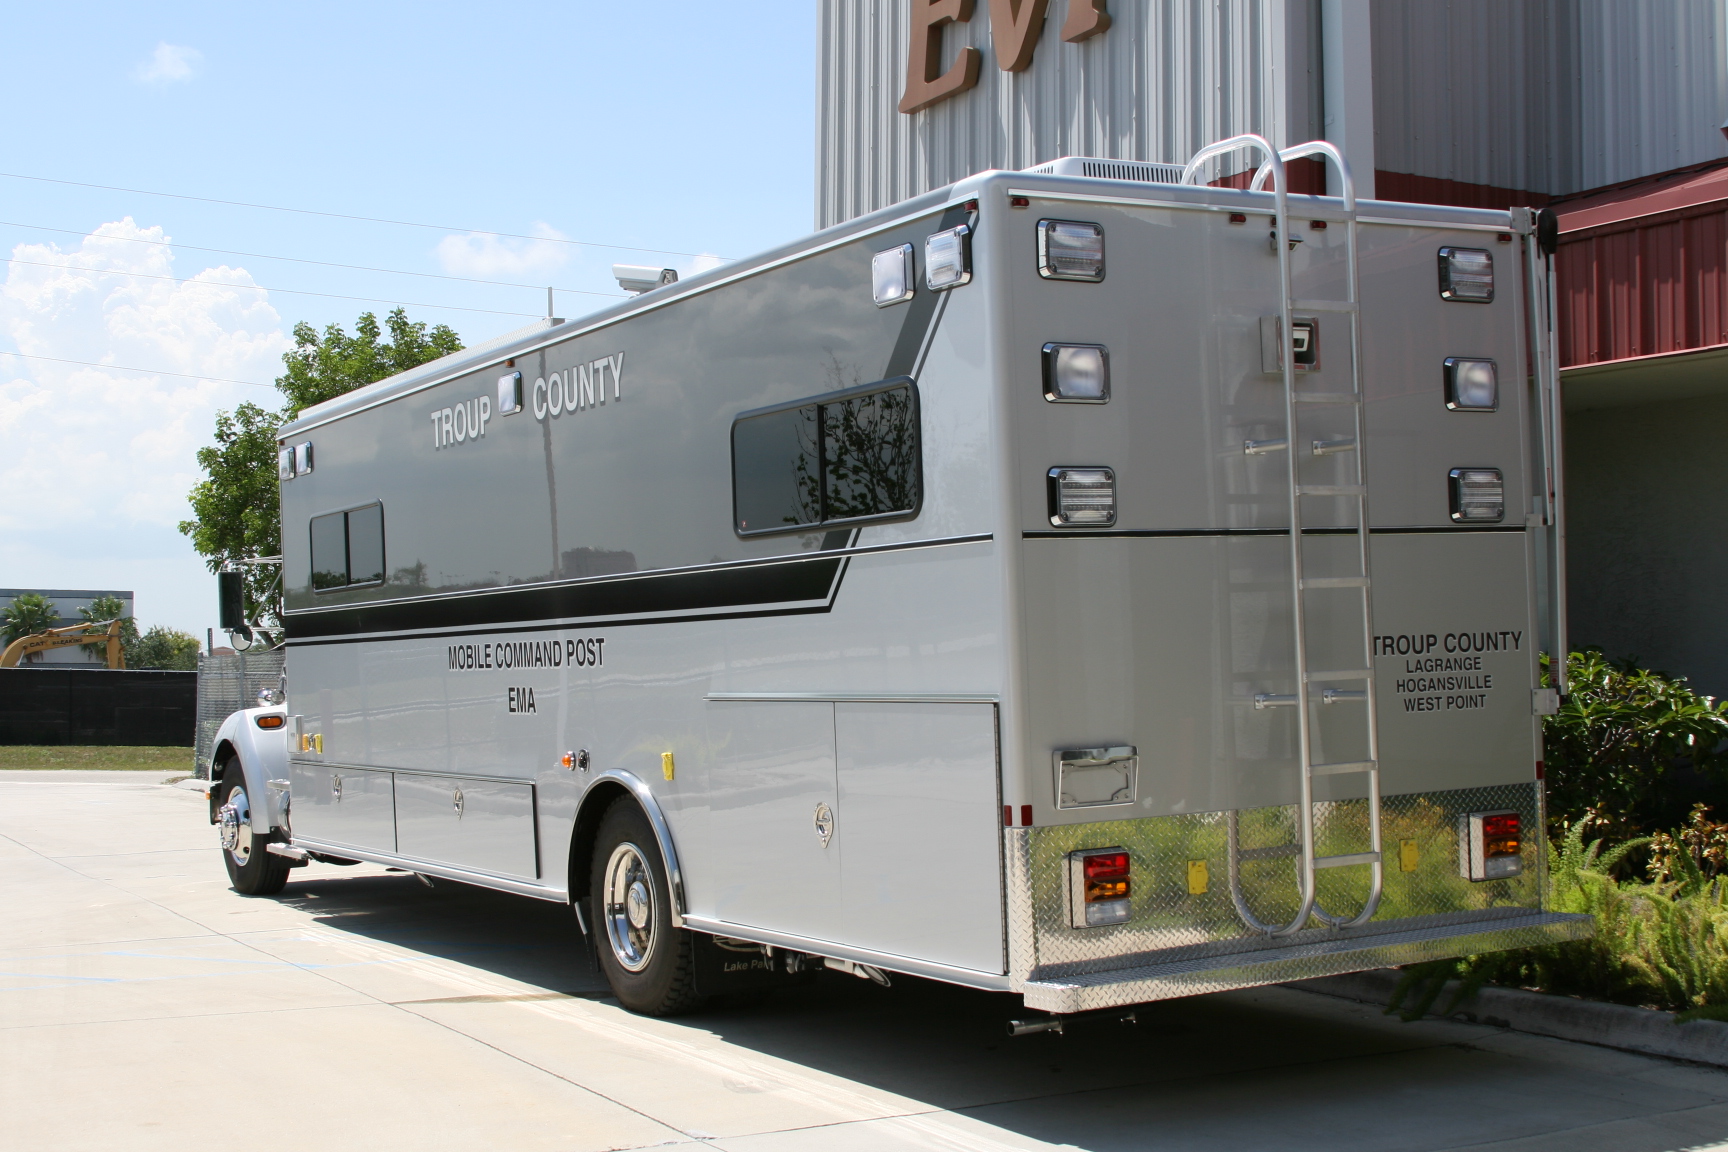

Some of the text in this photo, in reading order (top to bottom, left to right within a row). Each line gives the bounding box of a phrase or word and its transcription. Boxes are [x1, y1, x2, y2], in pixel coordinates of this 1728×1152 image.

[430, 351, 625, 449] TROUP COUNTY
[448, 637, 605, 670] MOBILE COMMAND POST
[1373, 630, 1523, 656] TROUP COUNTY
[1406, 656, 1482, 674] LAGRANGE
[1396, 674, 1493, 693] HOGANSVILLE
[507, 686, 537, 714] EMA
[1403, 694, 1487, 712] WEST POINT
[723, 960, 749, 972] Lake
